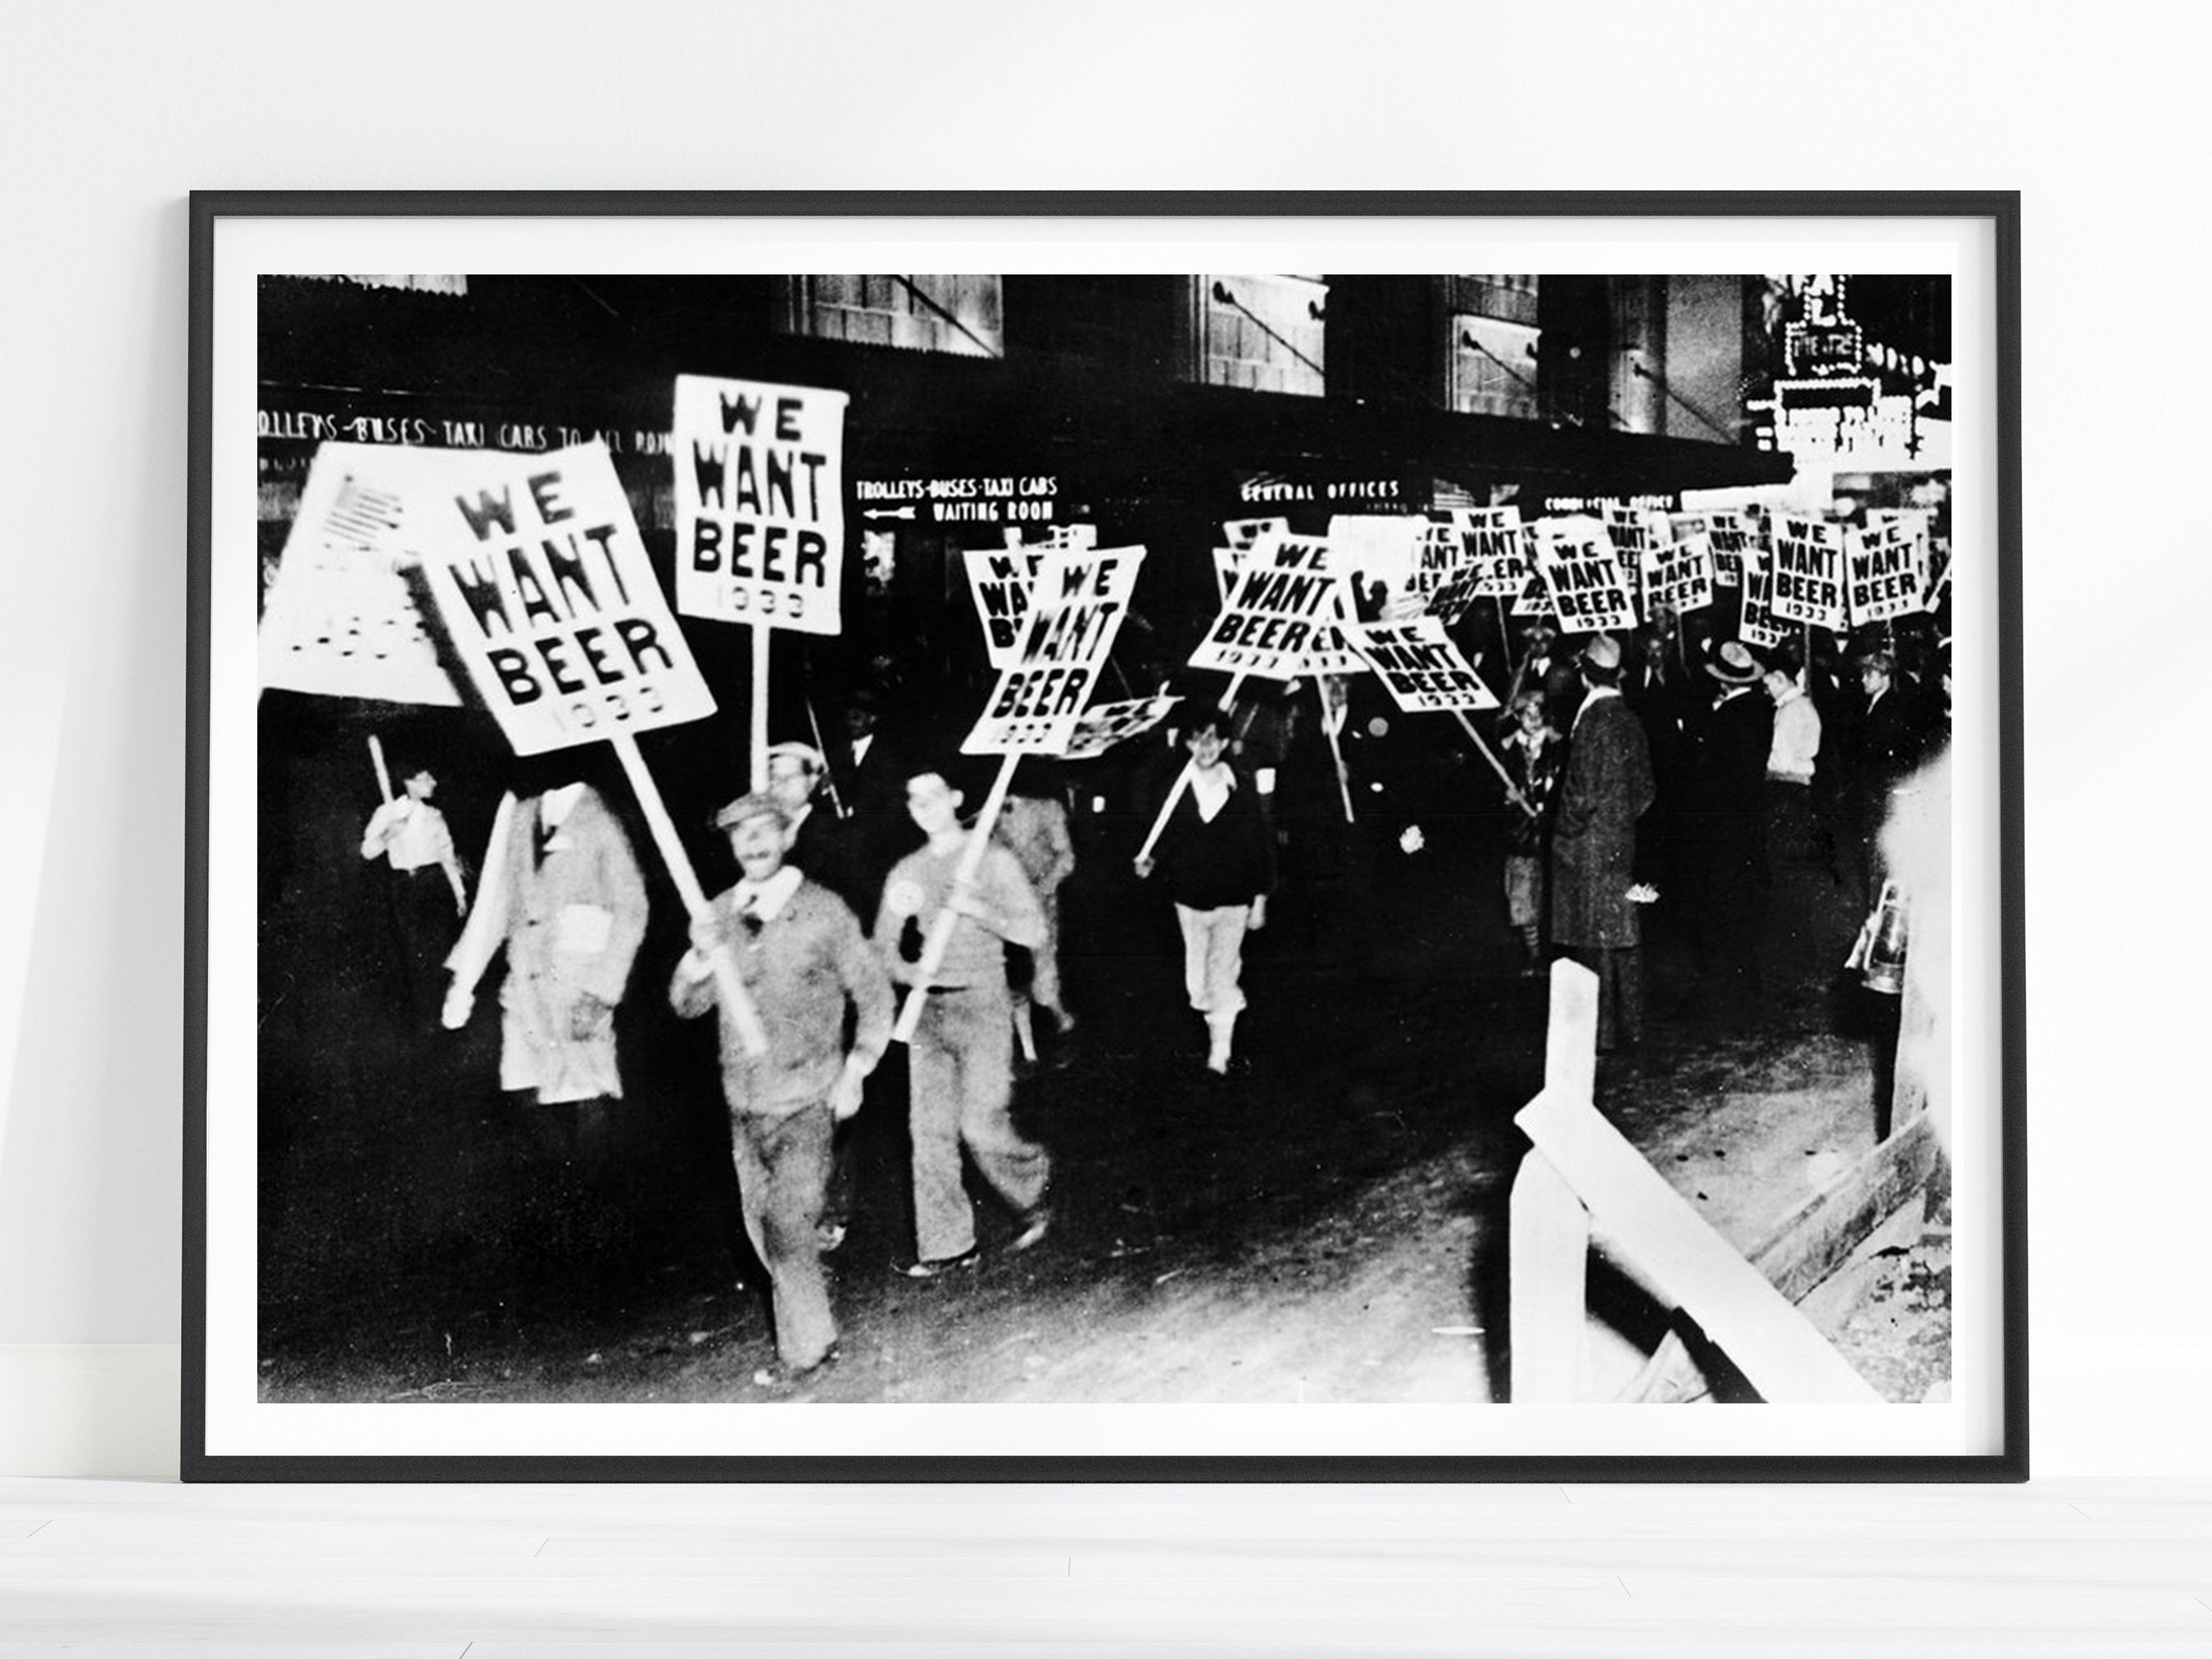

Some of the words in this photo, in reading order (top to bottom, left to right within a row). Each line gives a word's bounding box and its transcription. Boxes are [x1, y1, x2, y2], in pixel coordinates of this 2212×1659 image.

[719, 391, 804, 442] WE
[692, 437, 827, 523] WANT
[1328, 480, 1398, 499] OFFICES
[455, 470, 574, 542] WE
[933, 501, 999, 521] WAITING
[1008, 501, 1053, 520] ROOM
[1468, 512, 1506, 528] WE
[1462, 530, 1517, 558] WANT
[1787, 519, 1828, 544] WE
[1861, 526, 1901, 550] WE
[692, 516, 827, 588] BEER
[1275, 543, 1329, 570] WE
[1554, 542, 1599, 560] WE
[1656, 545, 1693, 564] WE
[1777, 538, 1838, 579] WANT
[1852, 542, 1912, 581] WANT
[447, 524, 630, 639] WANT
[1061, 560, 1119, 599] WE
[1548, 560, 1616, 592] WANT
[1648, 554, 1703, 588] WANT
[1236, 570, 1337, 616] WANT
[1557, 588, 1627, 617] BEER
[1776, 572, 1837, 609] BEER
[1853, 573, 1917, 607] BEER
[1786, 602, 1827, 621] 1933
[1212, 613, 1311, 653] BEER
[1364, 626, 1426, 645] WE
[1752, 629, 1777, 644] 193
[486, 617, 673, 707] BEER
[1364, 643, 1457, 670] WANT
[990, 668, 1090, 718] BEER
[1386, 670, 1481, 694] BEER
